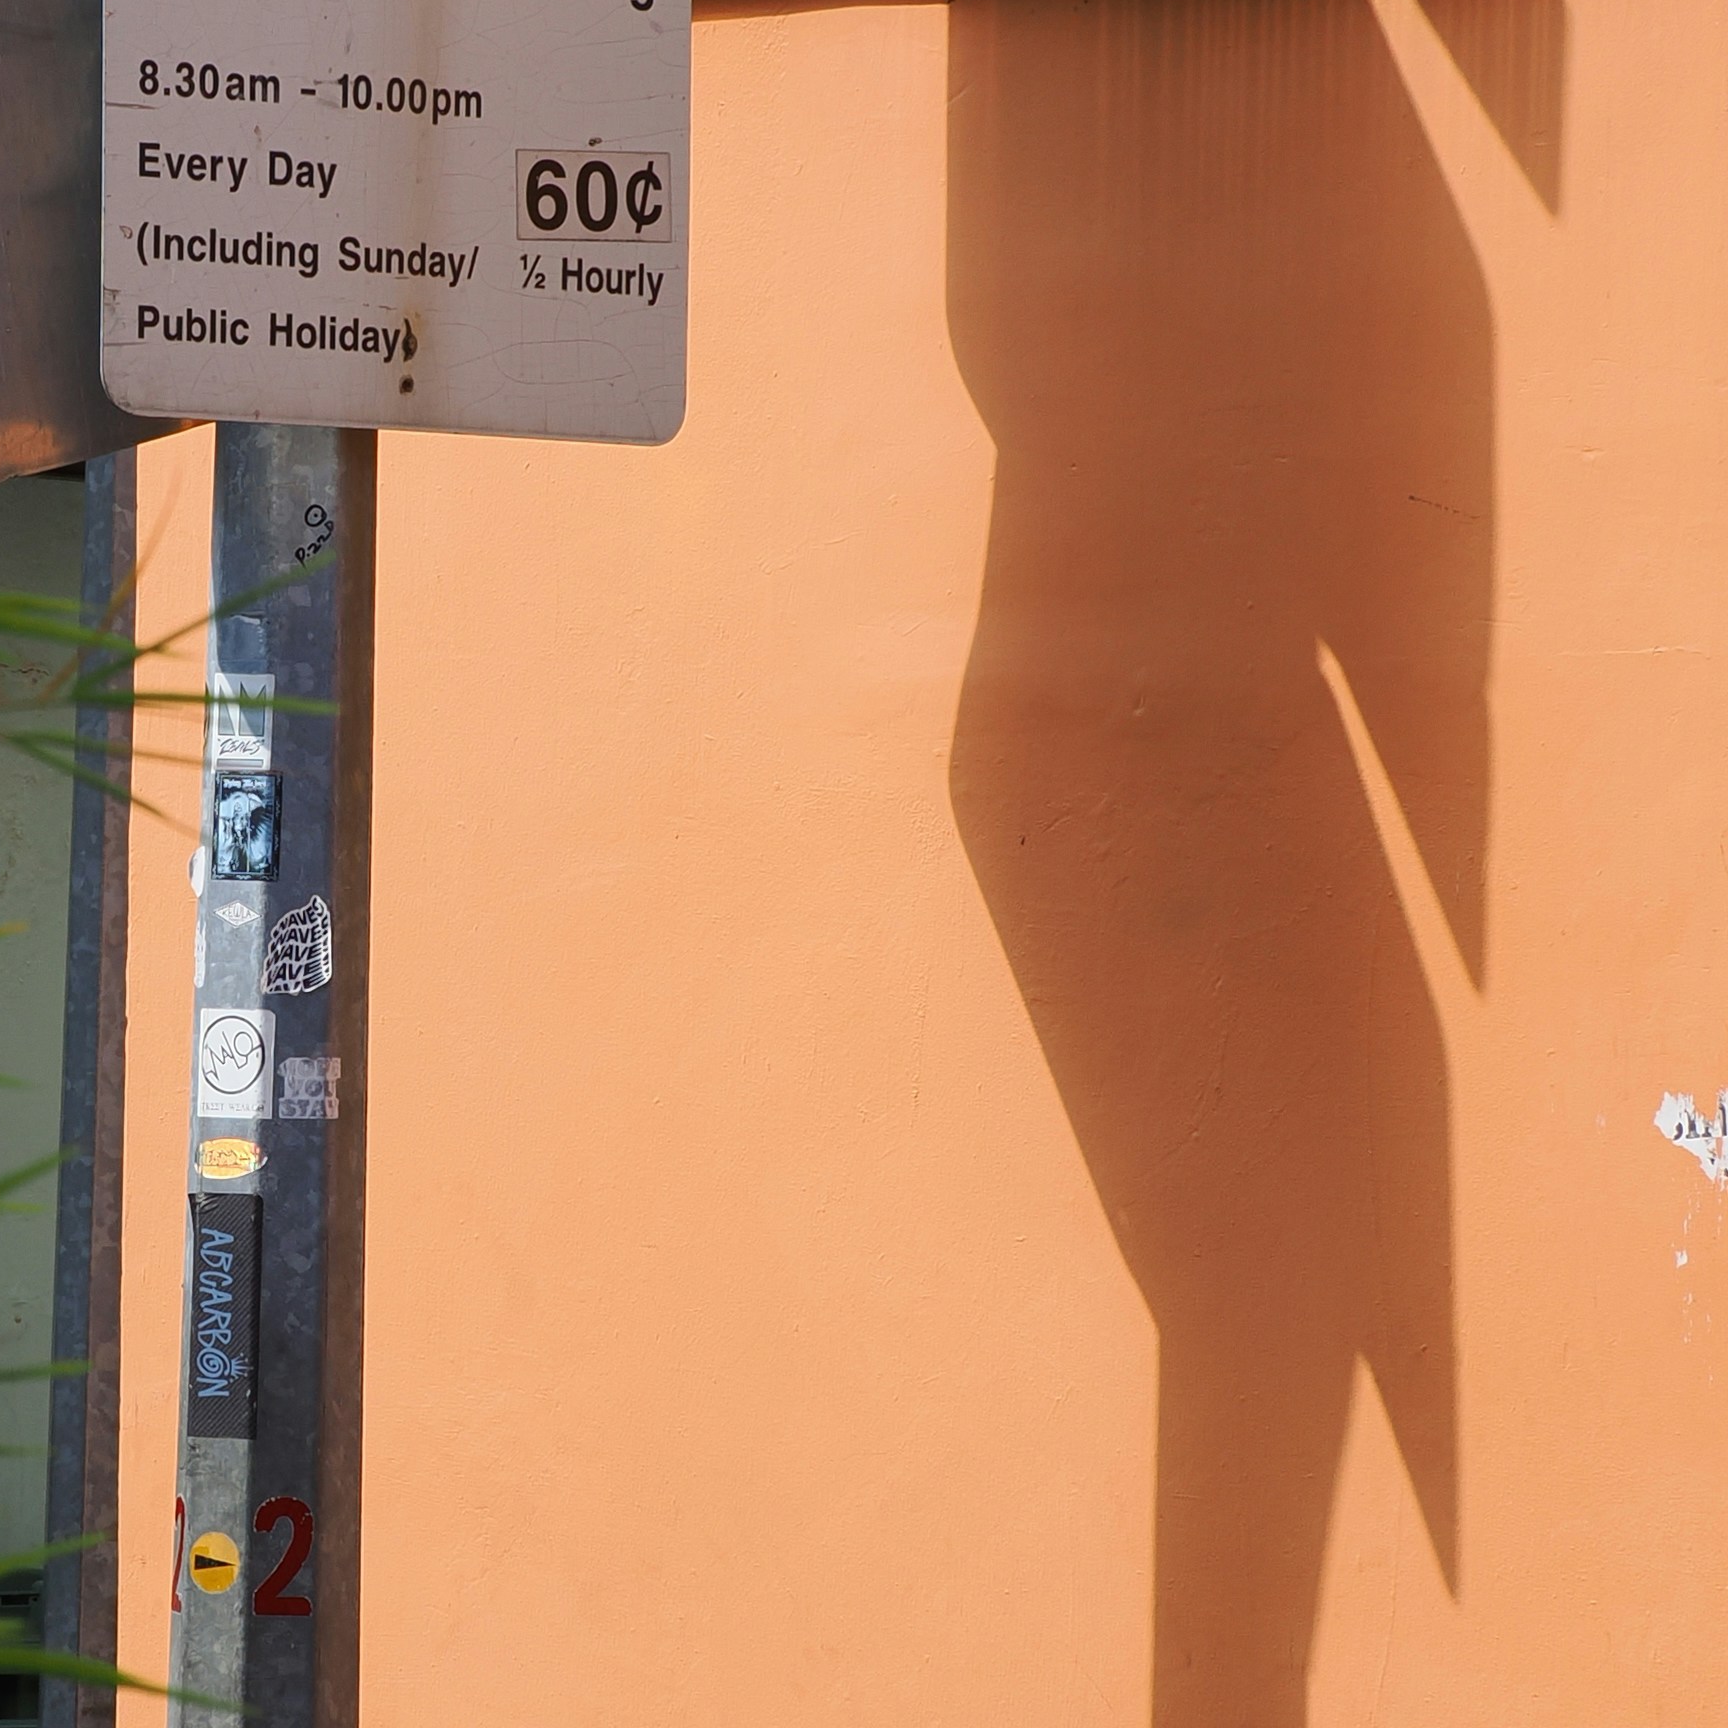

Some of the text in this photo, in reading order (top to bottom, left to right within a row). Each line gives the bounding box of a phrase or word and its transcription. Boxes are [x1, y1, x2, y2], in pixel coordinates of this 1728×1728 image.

[139, 60, 281, 104] 8.30am
[338, 73, 483, 125] 10.00pm
[139, 142, 337, 199] Every Day
[525, 158, 665, 234] 60¢
[137, 221, 480, 288] (Including Sunday/
[561, 258, 665, 306] Hourly
[138, 305, 418, 362] Public Holiday)
[253, 1495, 314, 1617] 2
